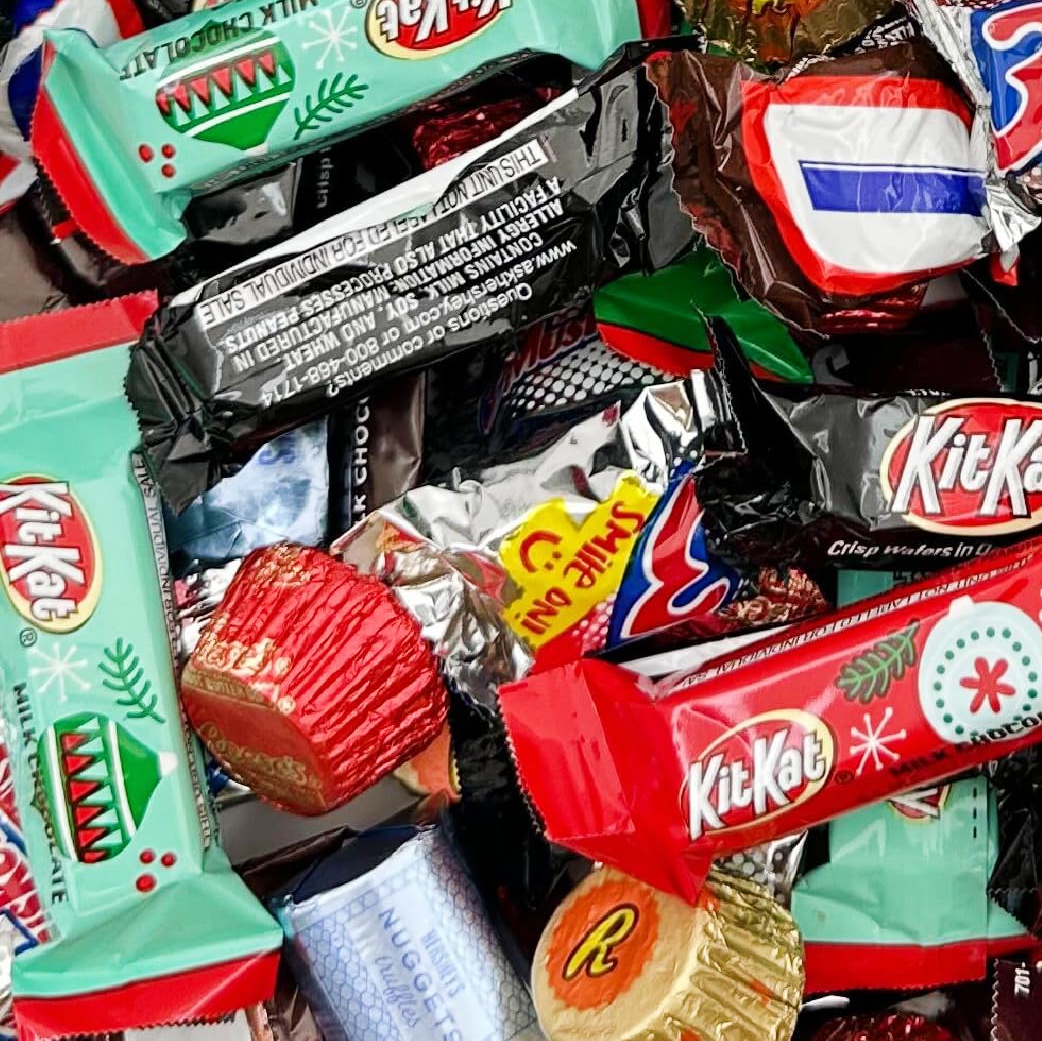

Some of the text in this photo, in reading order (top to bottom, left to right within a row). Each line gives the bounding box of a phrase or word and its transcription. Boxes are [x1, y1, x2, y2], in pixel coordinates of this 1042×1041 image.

[497, 143, 540, 178] THIS
[437, 222, 477, 251] THAT
[474, 185, 548, 232] FACILITY
[329, 229, 367, 261] FOR
[393, 239, 439, 273] ALSO
[233, 196, 566, 371] ALLERGY INFORMATION: MANUFACTURED IN
[241, 244, 334, 304] INDIVIDUAL
[274, 229, 545, 373] CONTAINS AND WHEAT.
[299, 261, 393, 317] PROCESSES
[398, 235, 581, 336] www.askhershey.com
[197, 287, 246, 325] SALE
[320, 279, 535, 397] Questions or comments?
[379, 324, 402, 346] or
[131, 458, 156, 499] SALE
[0, 481, 86, 623] KitKat
[827, 540, 880, 558] Crisp
[955, 541, 973, 556] in
[10, 682, 38, 747] MILK
[687, 730, 827, 841] KitKat
[563, 903, 640, 981] R
